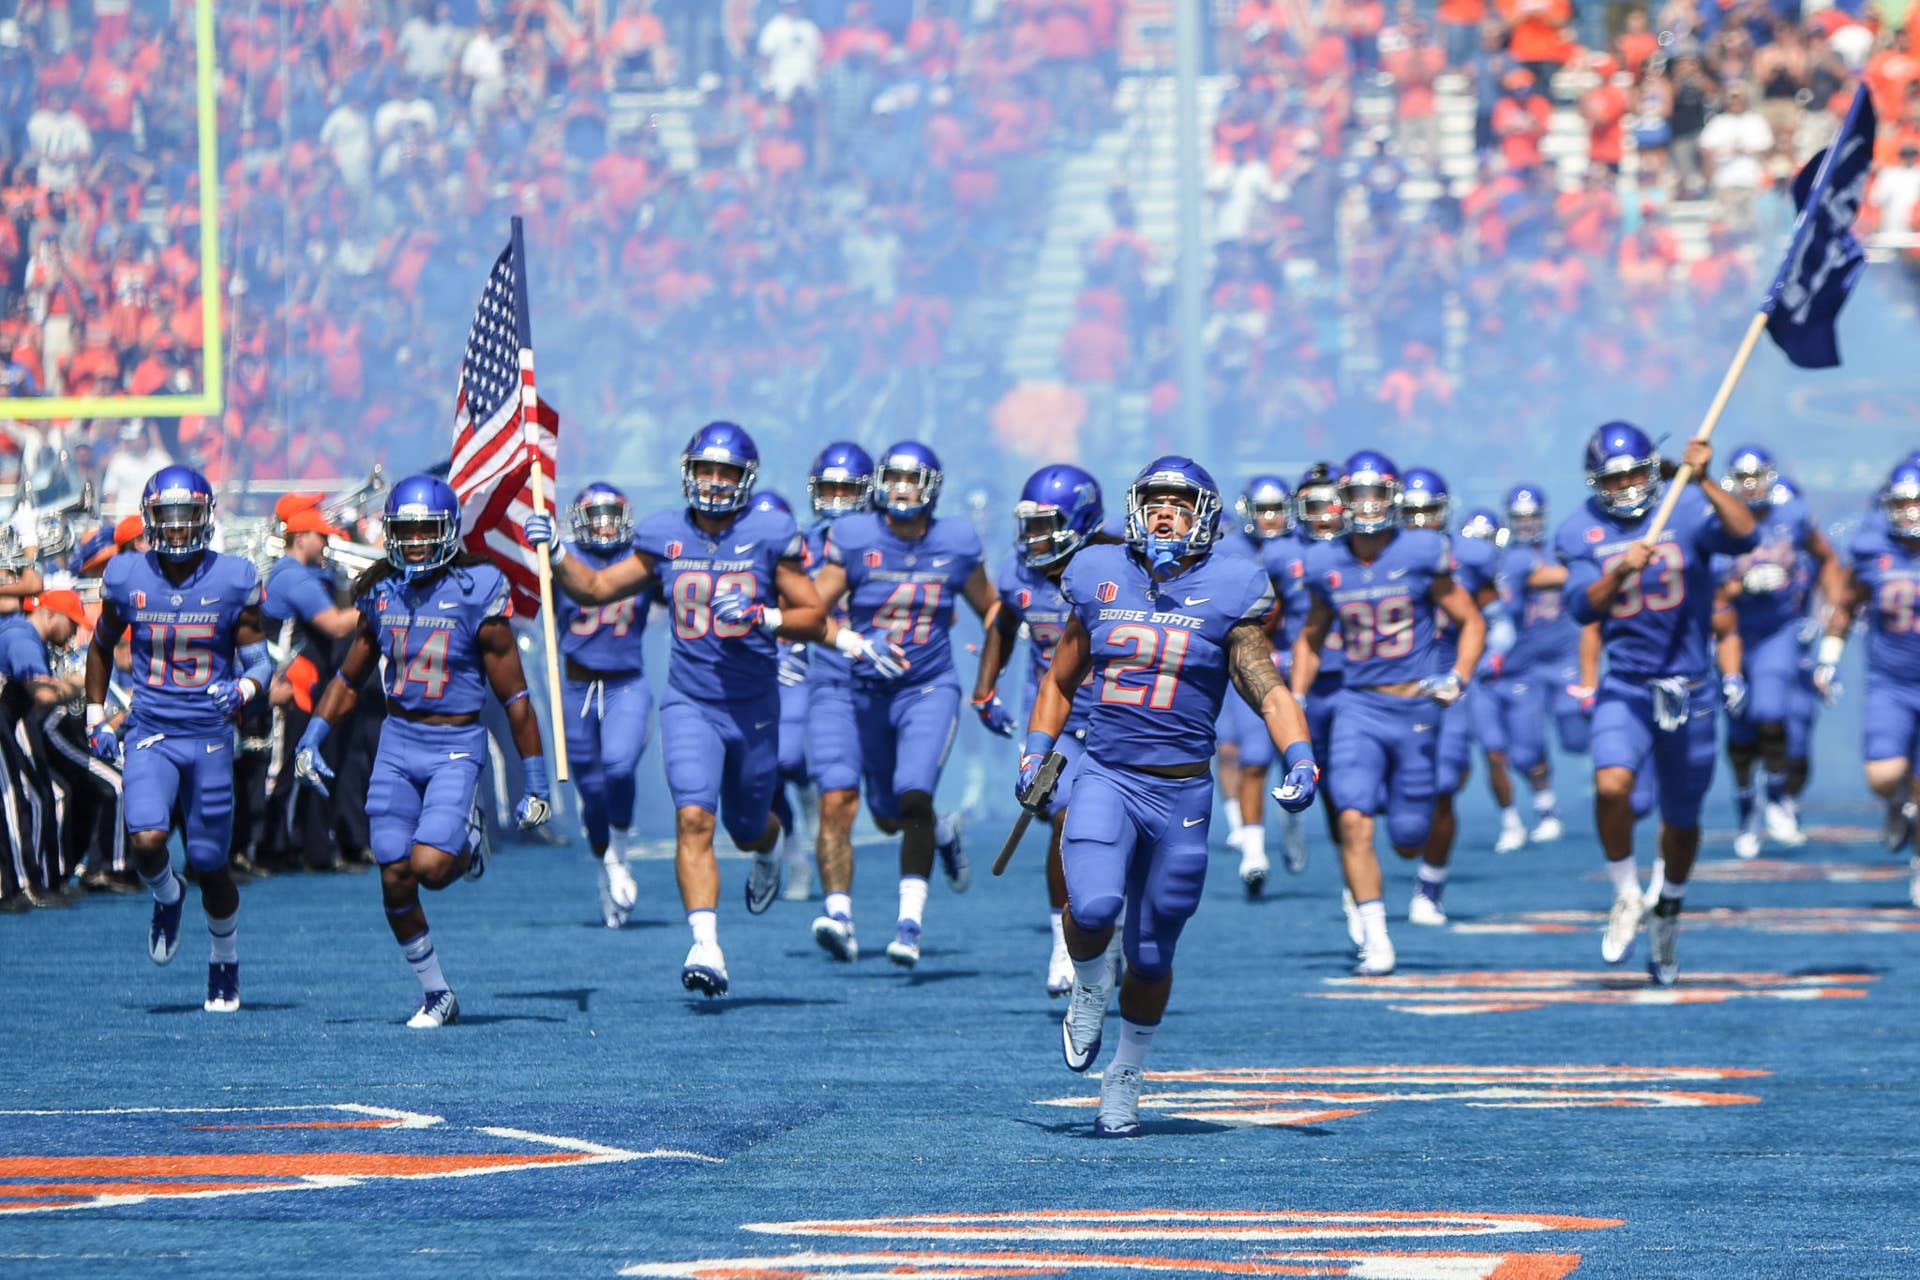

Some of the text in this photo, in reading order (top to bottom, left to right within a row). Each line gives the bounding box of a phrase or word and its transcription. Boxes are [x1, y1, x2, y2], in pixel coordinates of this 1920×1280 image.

[672, 559, 754, 572] BOISE STATE
[136, 611, 220, 624] BOISE STATE
[871, 582, 942, 645] 41
[1099, 609, 1205, 629] BOISE STATE
[147, 624, 216, 687] 15
[390, 627, 451, 698] 14
[1102, 623, 1190, 710] 21
